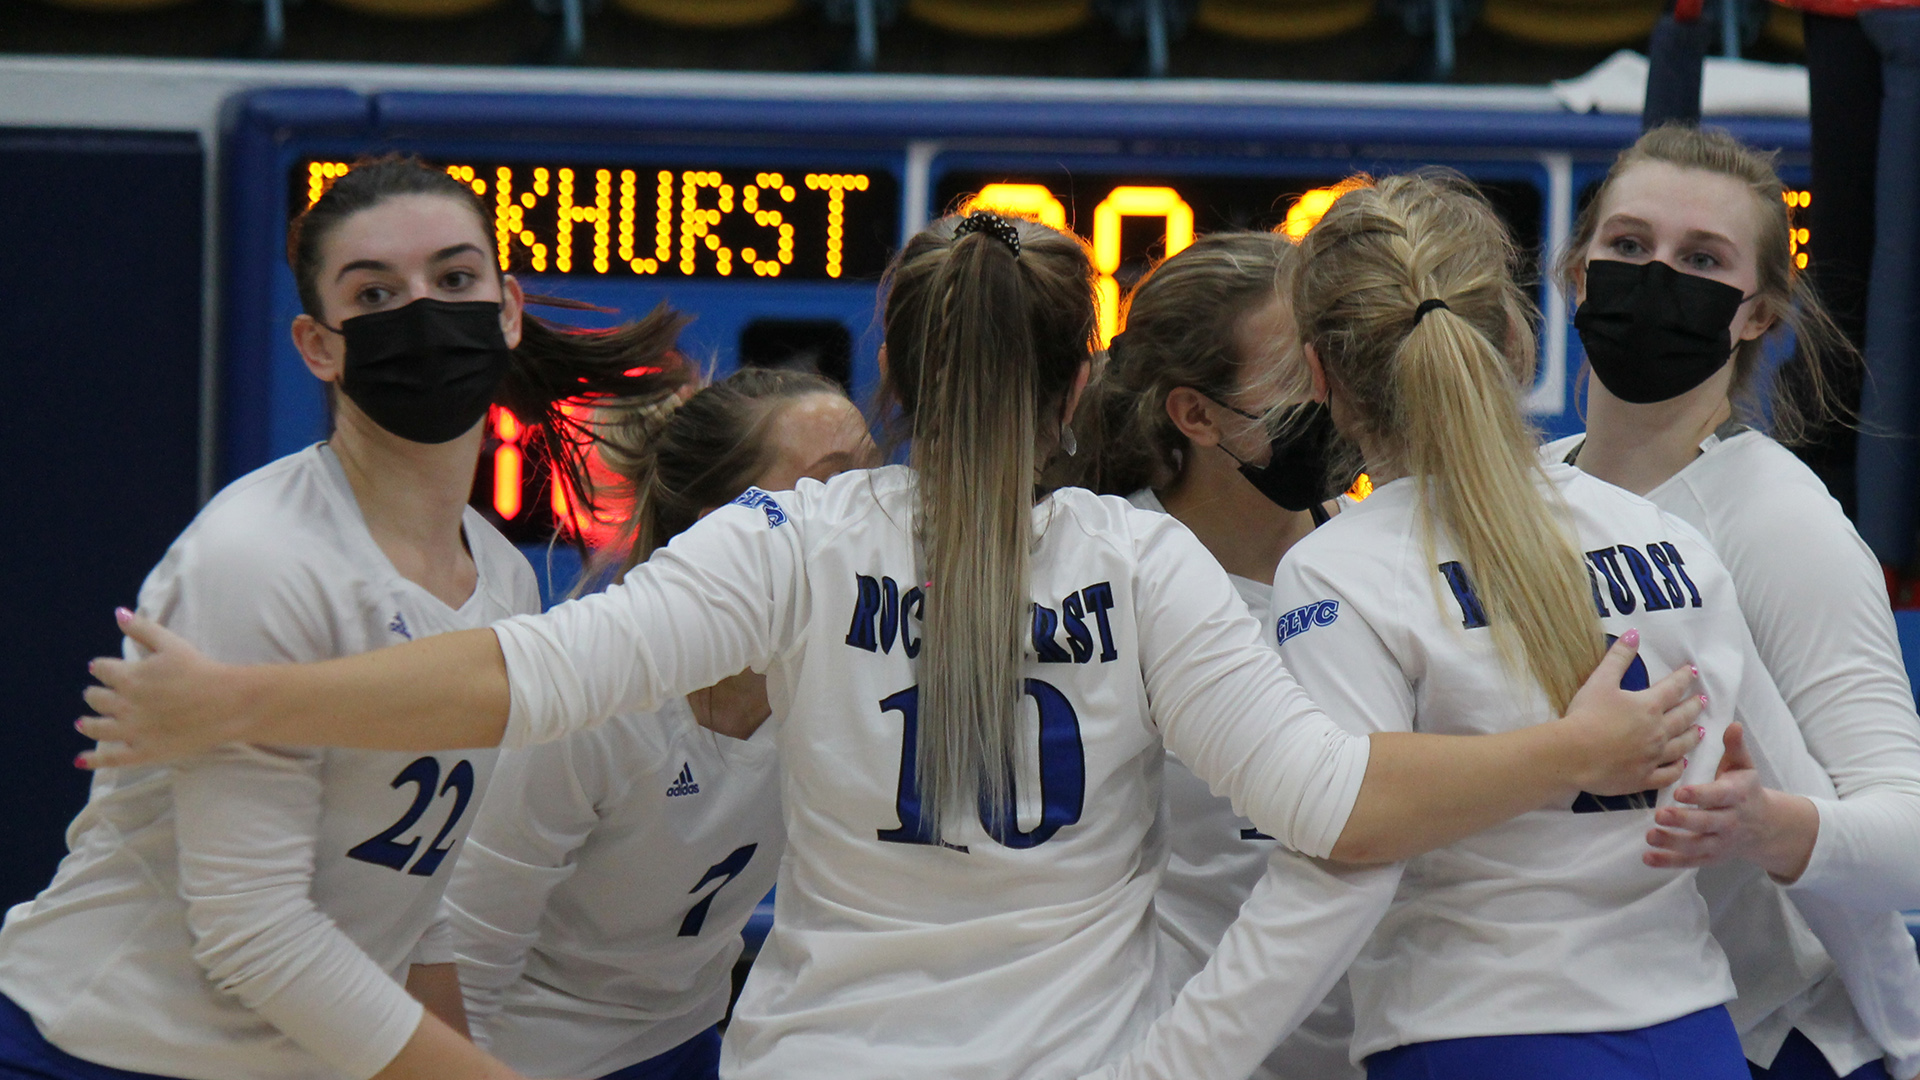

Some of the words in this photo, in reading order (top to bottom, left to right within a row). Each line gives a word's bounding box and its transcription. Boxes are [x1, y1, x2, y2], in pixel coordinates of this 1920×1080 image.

[304, 160, 870, 279] KHURST
[845, 571, 1118, 663] ROCRST
[1277, 599, 1339, 646] GLVC
[1438, 541, 1702, 629] RURST
[666, 783, 700, 797] adidas
[877, 678, 1086, 854] 10
[346, 756, 475, 877] 22
[677, 842, 758, 938] 7
